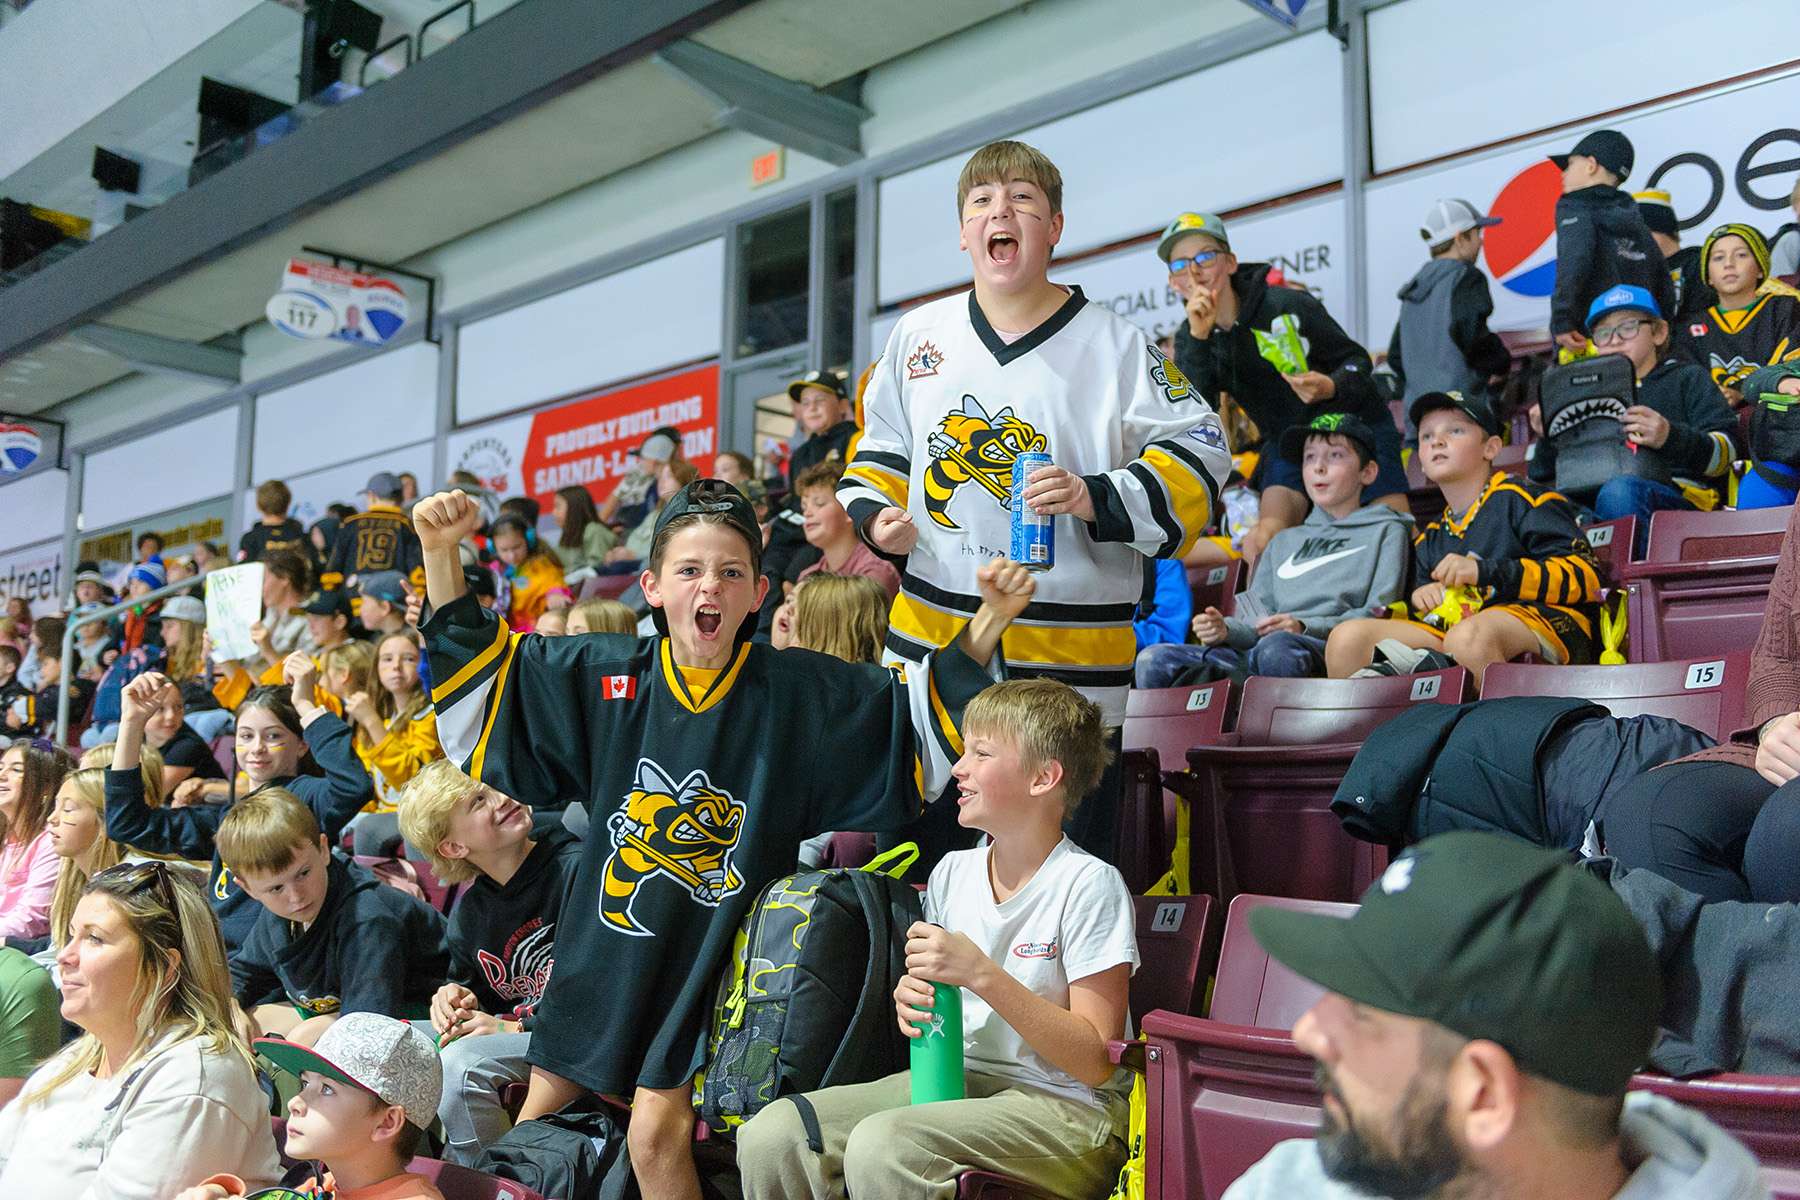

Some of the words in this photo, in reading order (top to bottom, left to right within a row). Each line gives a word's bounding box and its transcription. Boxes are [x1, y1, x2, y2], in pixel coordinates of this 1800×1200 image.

[288, 309, 317, 327] 117
[545, 419, 617, 458] PROUDLY
[618, 395, 702, 439] BUILDING
[1592, 530, 1606, 542] 14
[1294, 537, 1350, 561] NIKE
[1695, 667, 1714, 683] 15
[1418, 680, 1434, 694] 14
[1195, 692, 1208, 706] 13
[1160, 908, 1176, 926] 14
